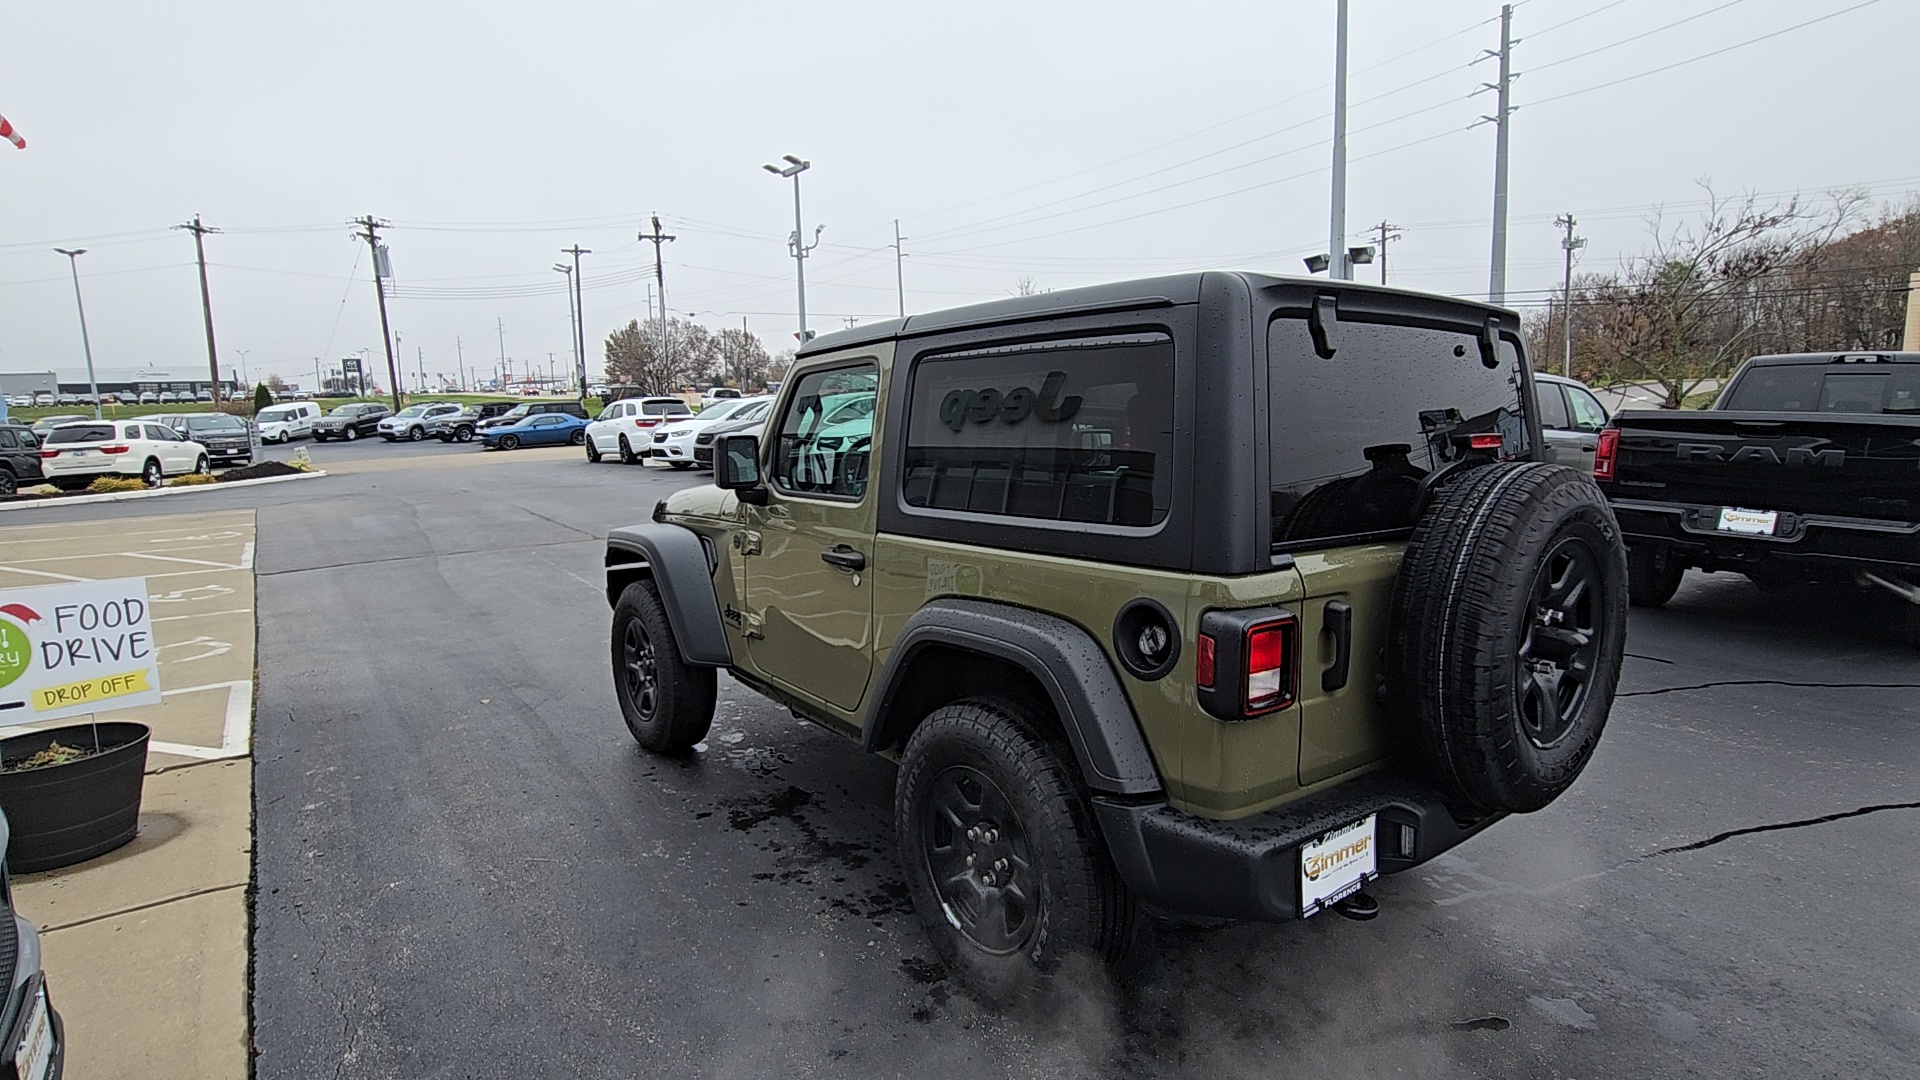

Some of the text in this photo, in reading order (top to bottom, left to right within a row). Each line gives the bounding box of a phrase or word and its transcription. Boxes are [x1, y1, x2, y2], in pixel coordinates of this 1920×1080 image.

[1677, 442, 1846, 467] RAM
[55, 598, 144, 633] FOOD
[41, 631, 149, 669] DRIVE
[44, 674, 136, 706] DROP OFF
[1322, 820, 1360, 843] Zimmer
[1305, 834, 1372, 880] Zimmer
[1324, 882, 1362, 909] FLORENCE
